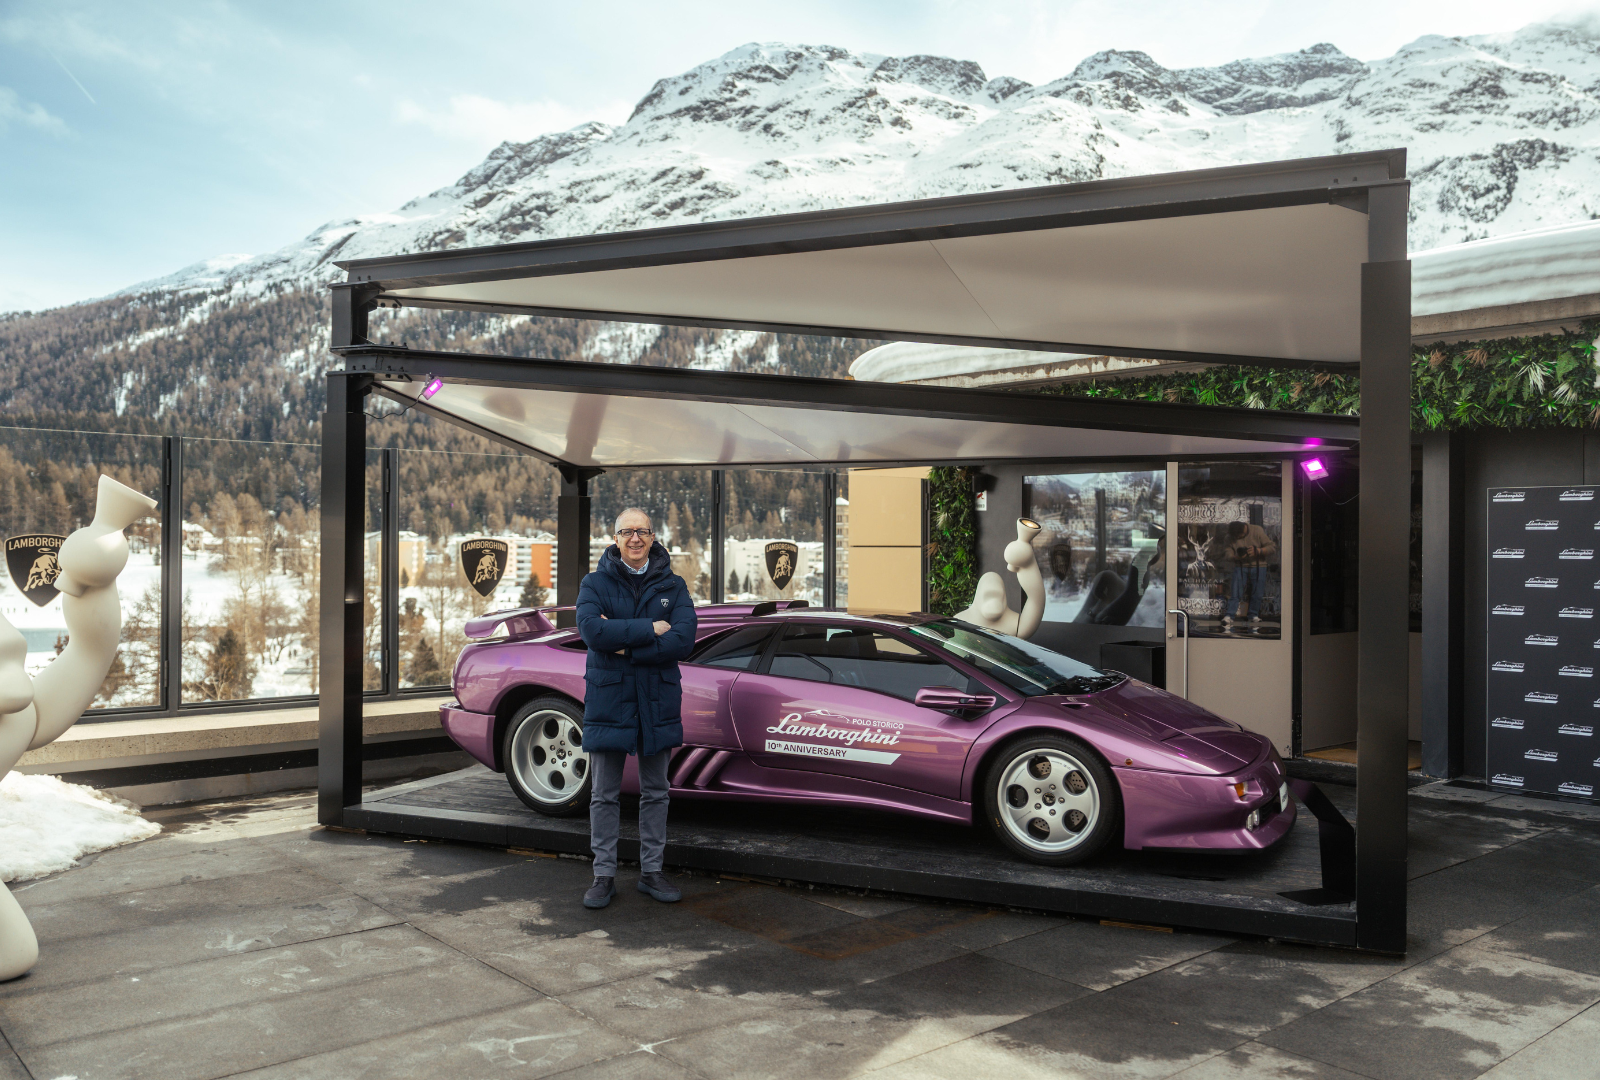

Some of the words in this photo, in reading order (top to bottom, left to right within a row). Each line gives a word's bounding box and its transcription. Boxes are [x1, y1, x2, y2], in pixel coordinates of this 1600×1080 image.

[463, 541, 507, 552] LAMBORGHINI
[766, 713, 901, 746] Lamborghini
[852, 718, 872, 727] POLO
[872, 720, 904, 730] STORICO
[767, 742, 783, 750] 10th
[783, 743, 847, 758] ANNIVERSARY
